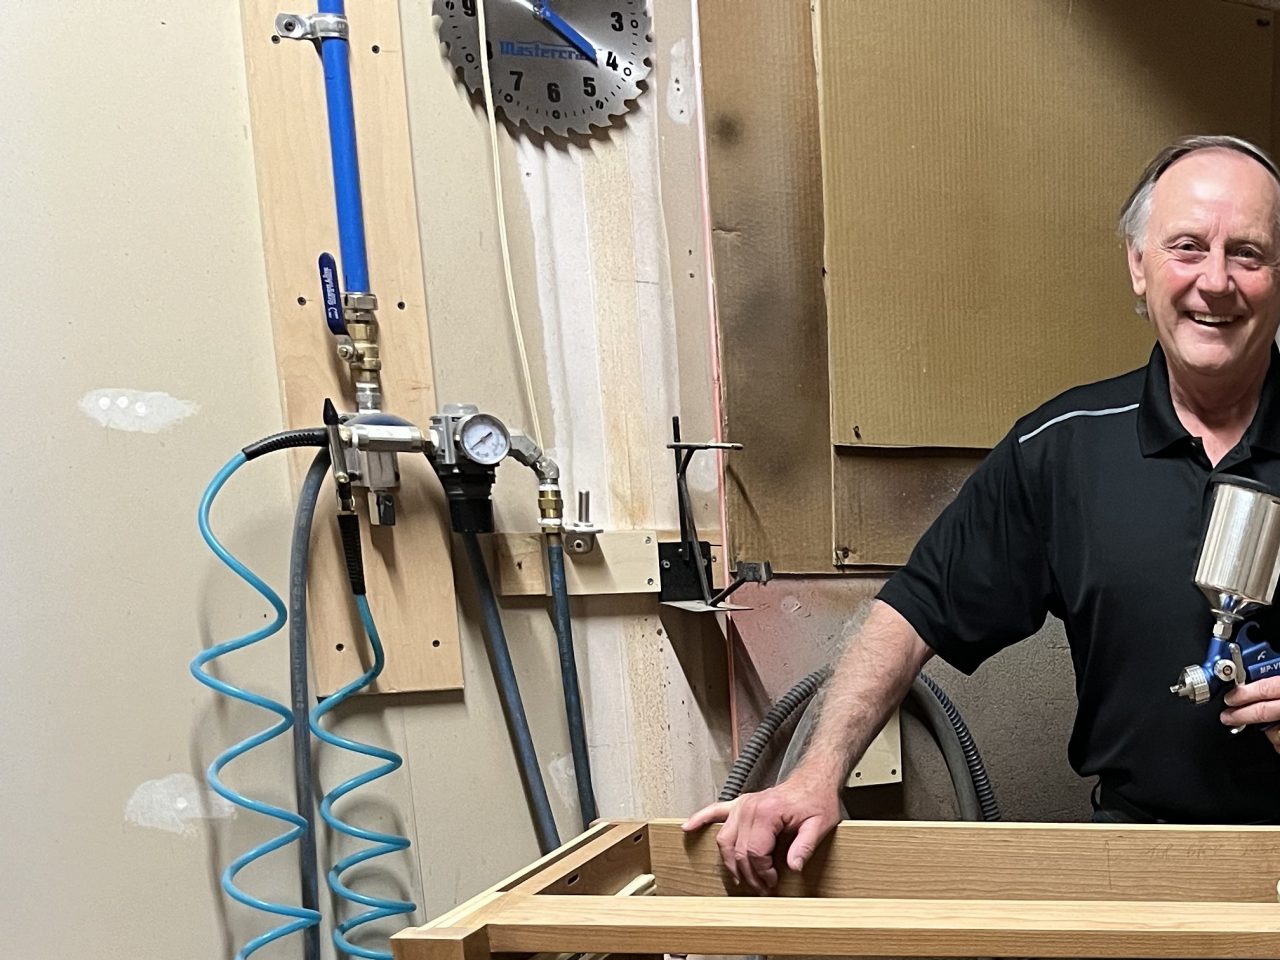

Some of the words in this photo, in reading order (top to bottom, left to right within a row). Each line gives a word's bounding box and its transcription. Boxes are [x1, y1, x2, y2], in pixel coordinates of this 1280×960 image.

[611, 12, 624, 32] 3
[606, 51, 619, 71] 4
[509, 71, 523, 91] 7
[582, 77, 596, 97] 5
[547, 83, 561, 102] 6
